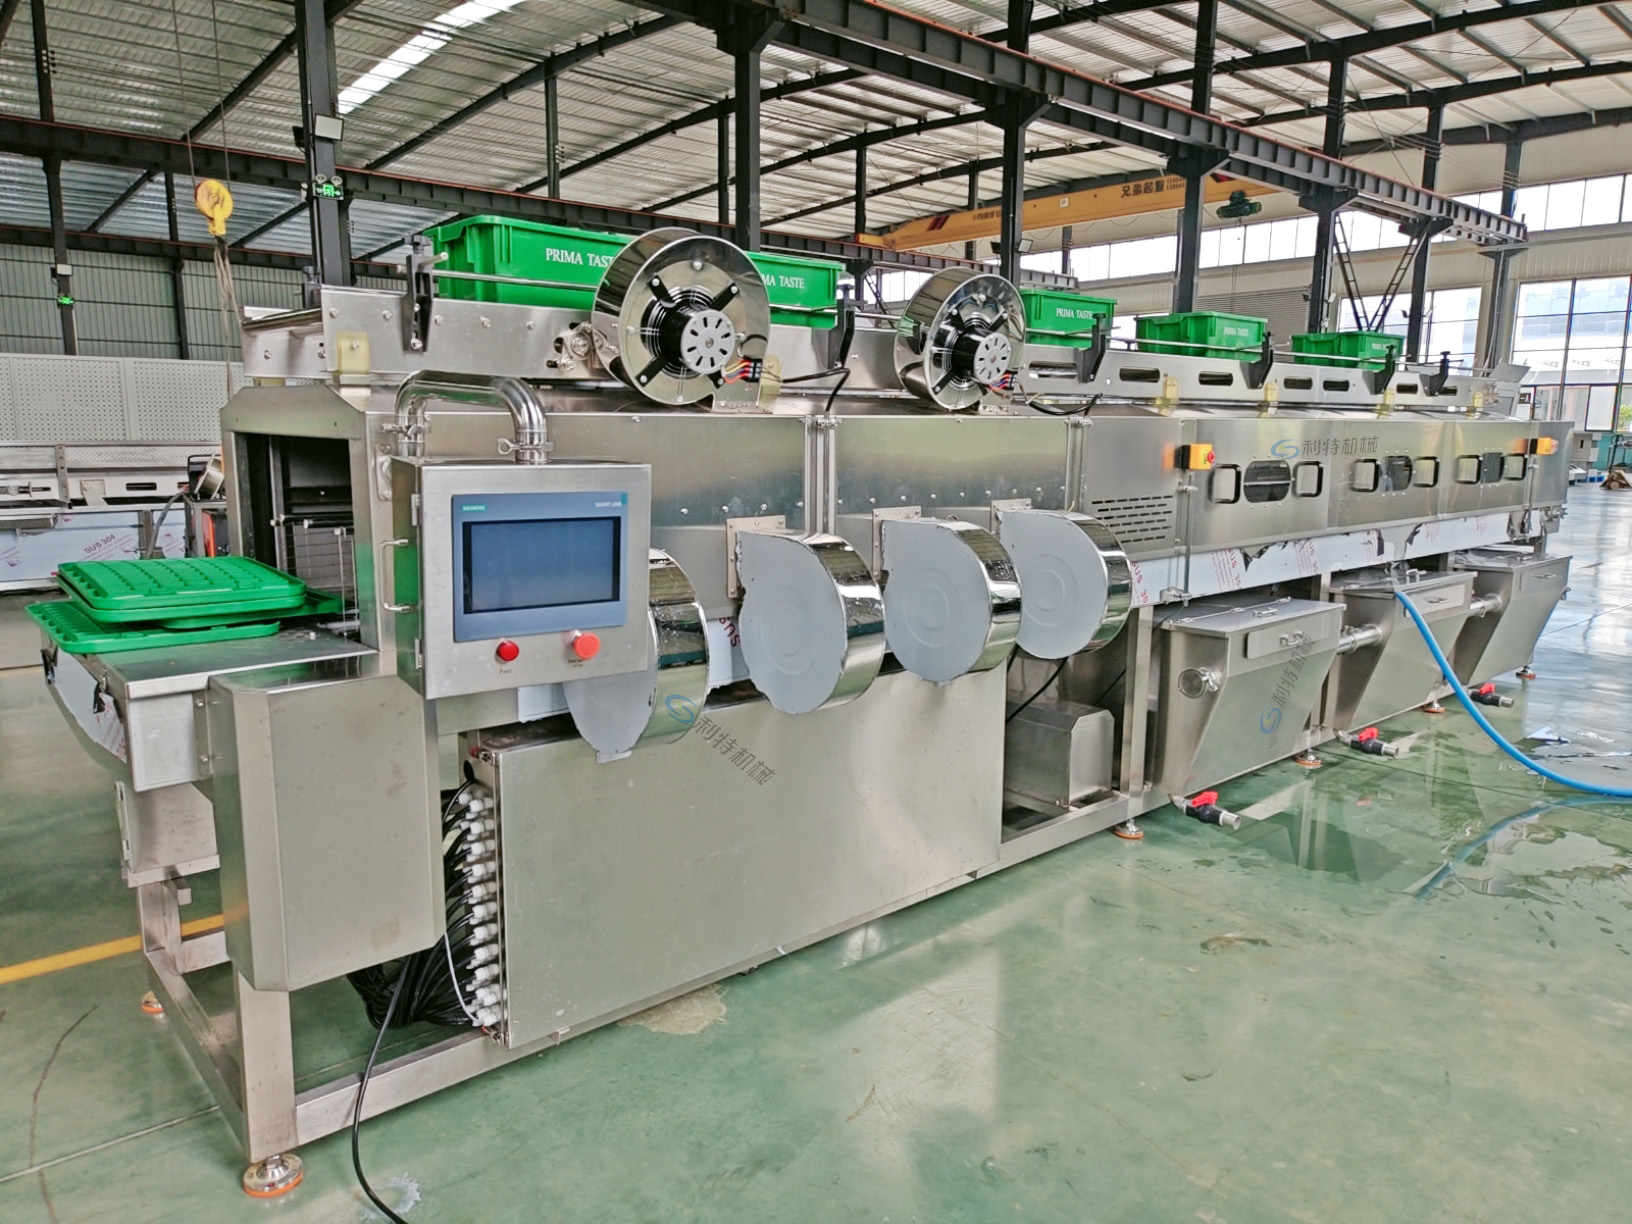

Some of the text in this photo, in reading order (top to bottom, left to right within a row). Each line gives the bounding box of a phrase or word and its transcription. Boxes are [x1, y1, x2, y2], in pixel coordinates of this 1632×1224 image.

[1121, 180, 1165, 199] 兄弟起重
[545, 247, 615, 268] PRIMA TAST
[779, 274, 806, 289] TASTE
[1056, 307, 1075, 318] PRIMA
